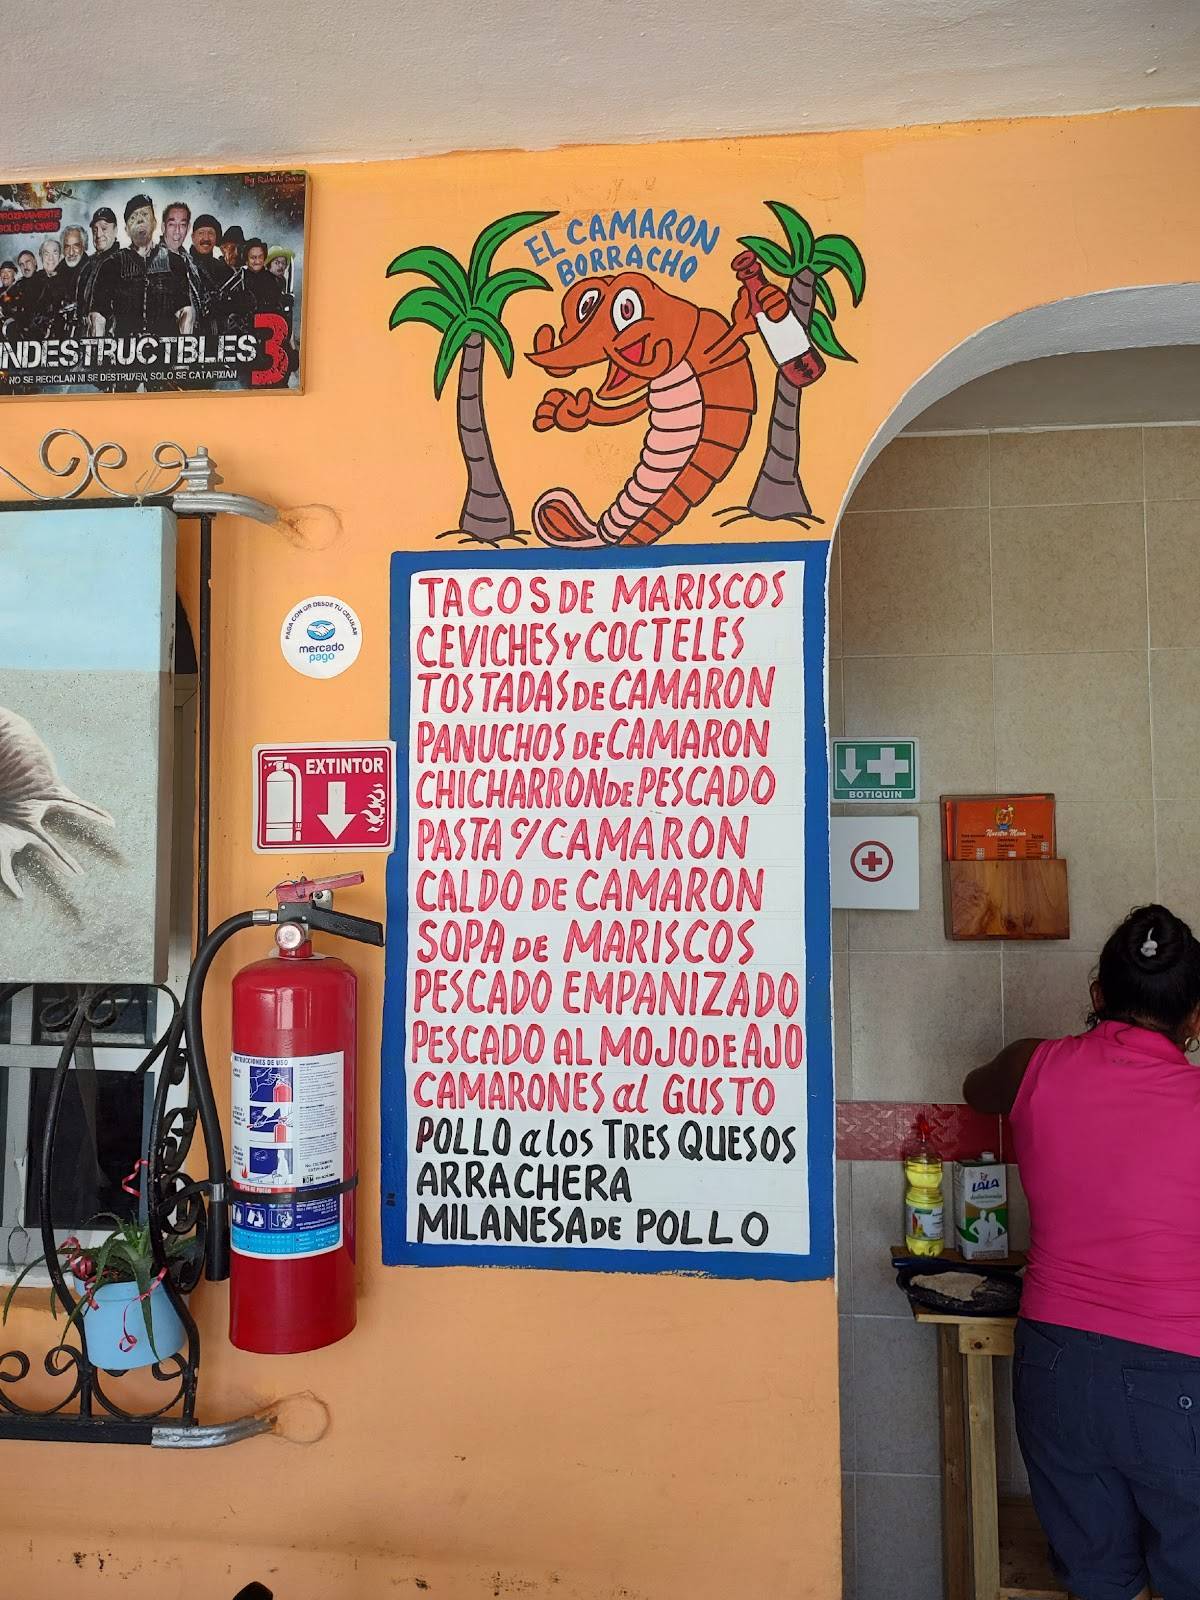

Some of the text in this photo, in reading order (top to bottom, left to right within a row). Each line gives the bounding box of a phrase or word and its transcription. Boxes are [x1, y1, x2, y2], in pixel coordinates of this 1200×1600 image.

[524, 208, 720, 267] EL CAMARON
[557, 245, 697, 286] BORRACHO
[251, 312, 289, 385] 3
[9, 376, 20, 384] NO
[36, 374, 76, 383] RECICLAN
[78, 374, 86, 382] NI
[88, 373, 98, 382] SE
[150, 371, 173, 380] SOLO
[176, 371, 186, 379] SE
[419, 571, 785, 618] TACOS DE MARISCOS
[285, 622, 294, 640] PAGA
[292, 609, 304, 622] CON
[303, 603, 312, 612] QR
[334, 604, 344, 612] TU
[342, 610, 358, 636] CELULAR
[417, 623, 559, 668] CEVICHES
[585, 617, 744, 662] COCTELES
[299, 643, 345, 653] mercado
[309, 652, 335, 664] pago
[418, 666, 775, 713] TOSTADAS DE CAMARON
[418, 718, 769, 763] PANUCHOS DE CAMARON
[306, 757, 384, 774] EXTINTOR
[416, 765, 776, 809] CHICHARRON DE PESCADO
[849, 790, 902, 799] BOTIQUIN
[418, 817, 501, 861] PASTA
[416, 867, 764, 913] CALDO DE CAMARON
[417, 919, 754, 965] SOPA DE MARISCOS
[414, 969, 798, 1017] PESCADO EMPANIZADO
[412, 1020, 802, 1069] PESCADO AL MOJO DE AJO
[414, 1072, 775, 1115] CAMARONES al GUSTO
[416, 1116, 511, 1156] POLLO
[602, 1119, 670, 1160] TRES
[678, 1120, 795, 1164] QUESOS
[417, 1161, 632, 1203] ARRACHERA
[972, 1178, 1000, 1192] LALA
[417, 1203, 768, 1246] MILANESA DE POLLO
